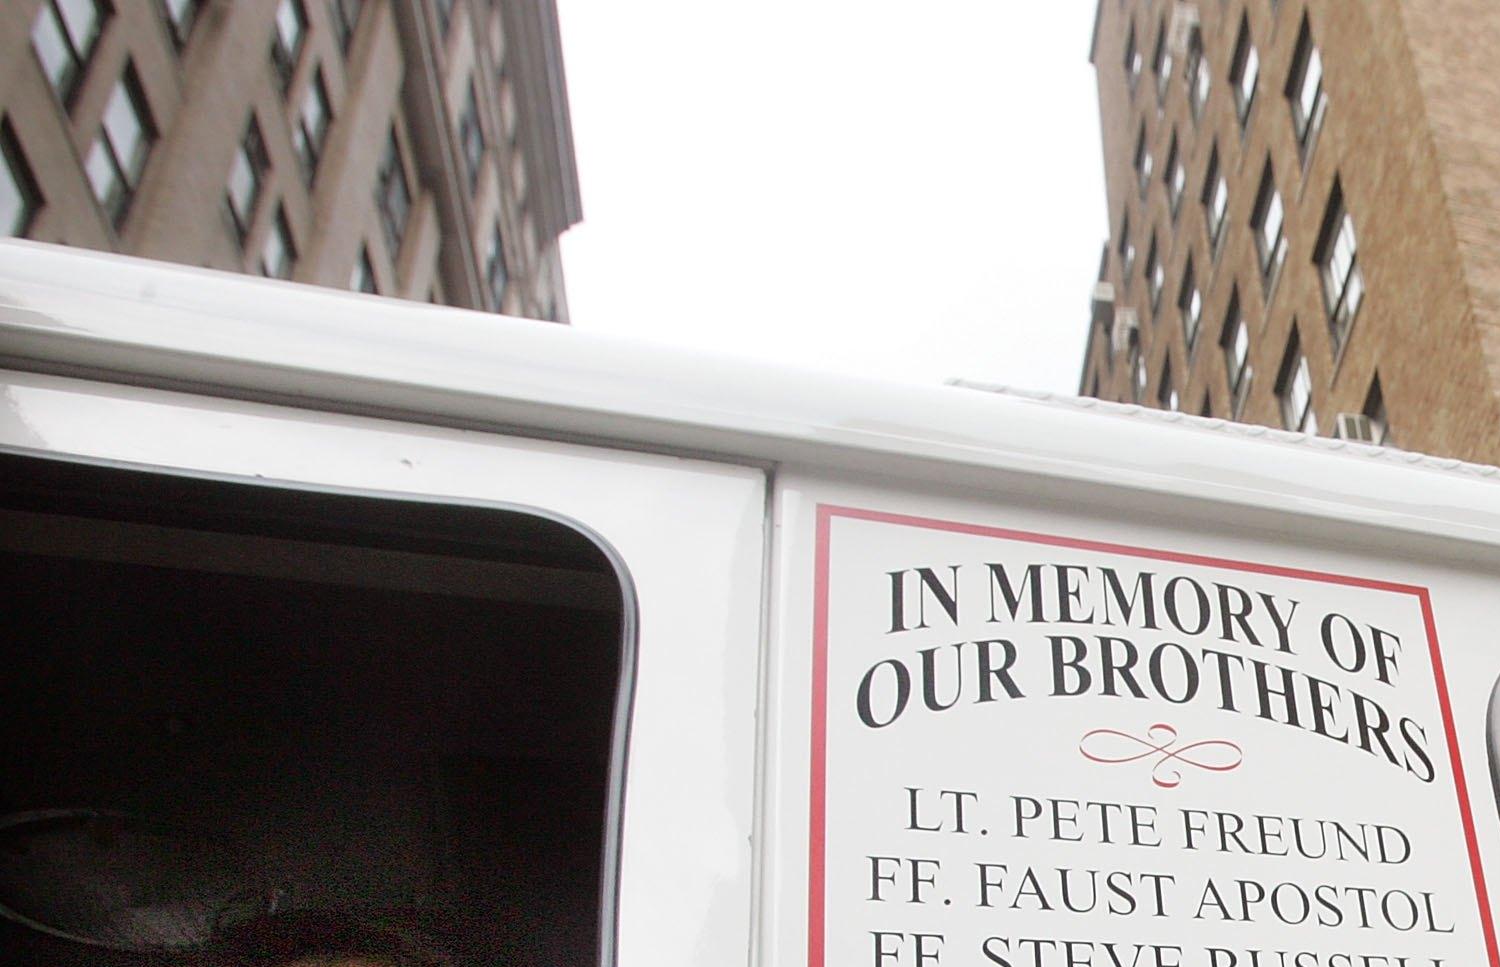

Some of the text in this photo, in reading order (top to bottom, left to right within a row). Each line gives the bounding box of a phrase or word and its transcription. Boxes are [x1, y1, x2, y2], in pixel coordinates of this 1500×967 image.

[885, 562, 1401, 687] IN MEMORY OF
[856, 634, 1436, 784] OUR BROTHERS
[905, 787, 1412, 865] LT. PETE FREUND
[866, 855, 1456, 934] FF. FAUST APOSTOL
